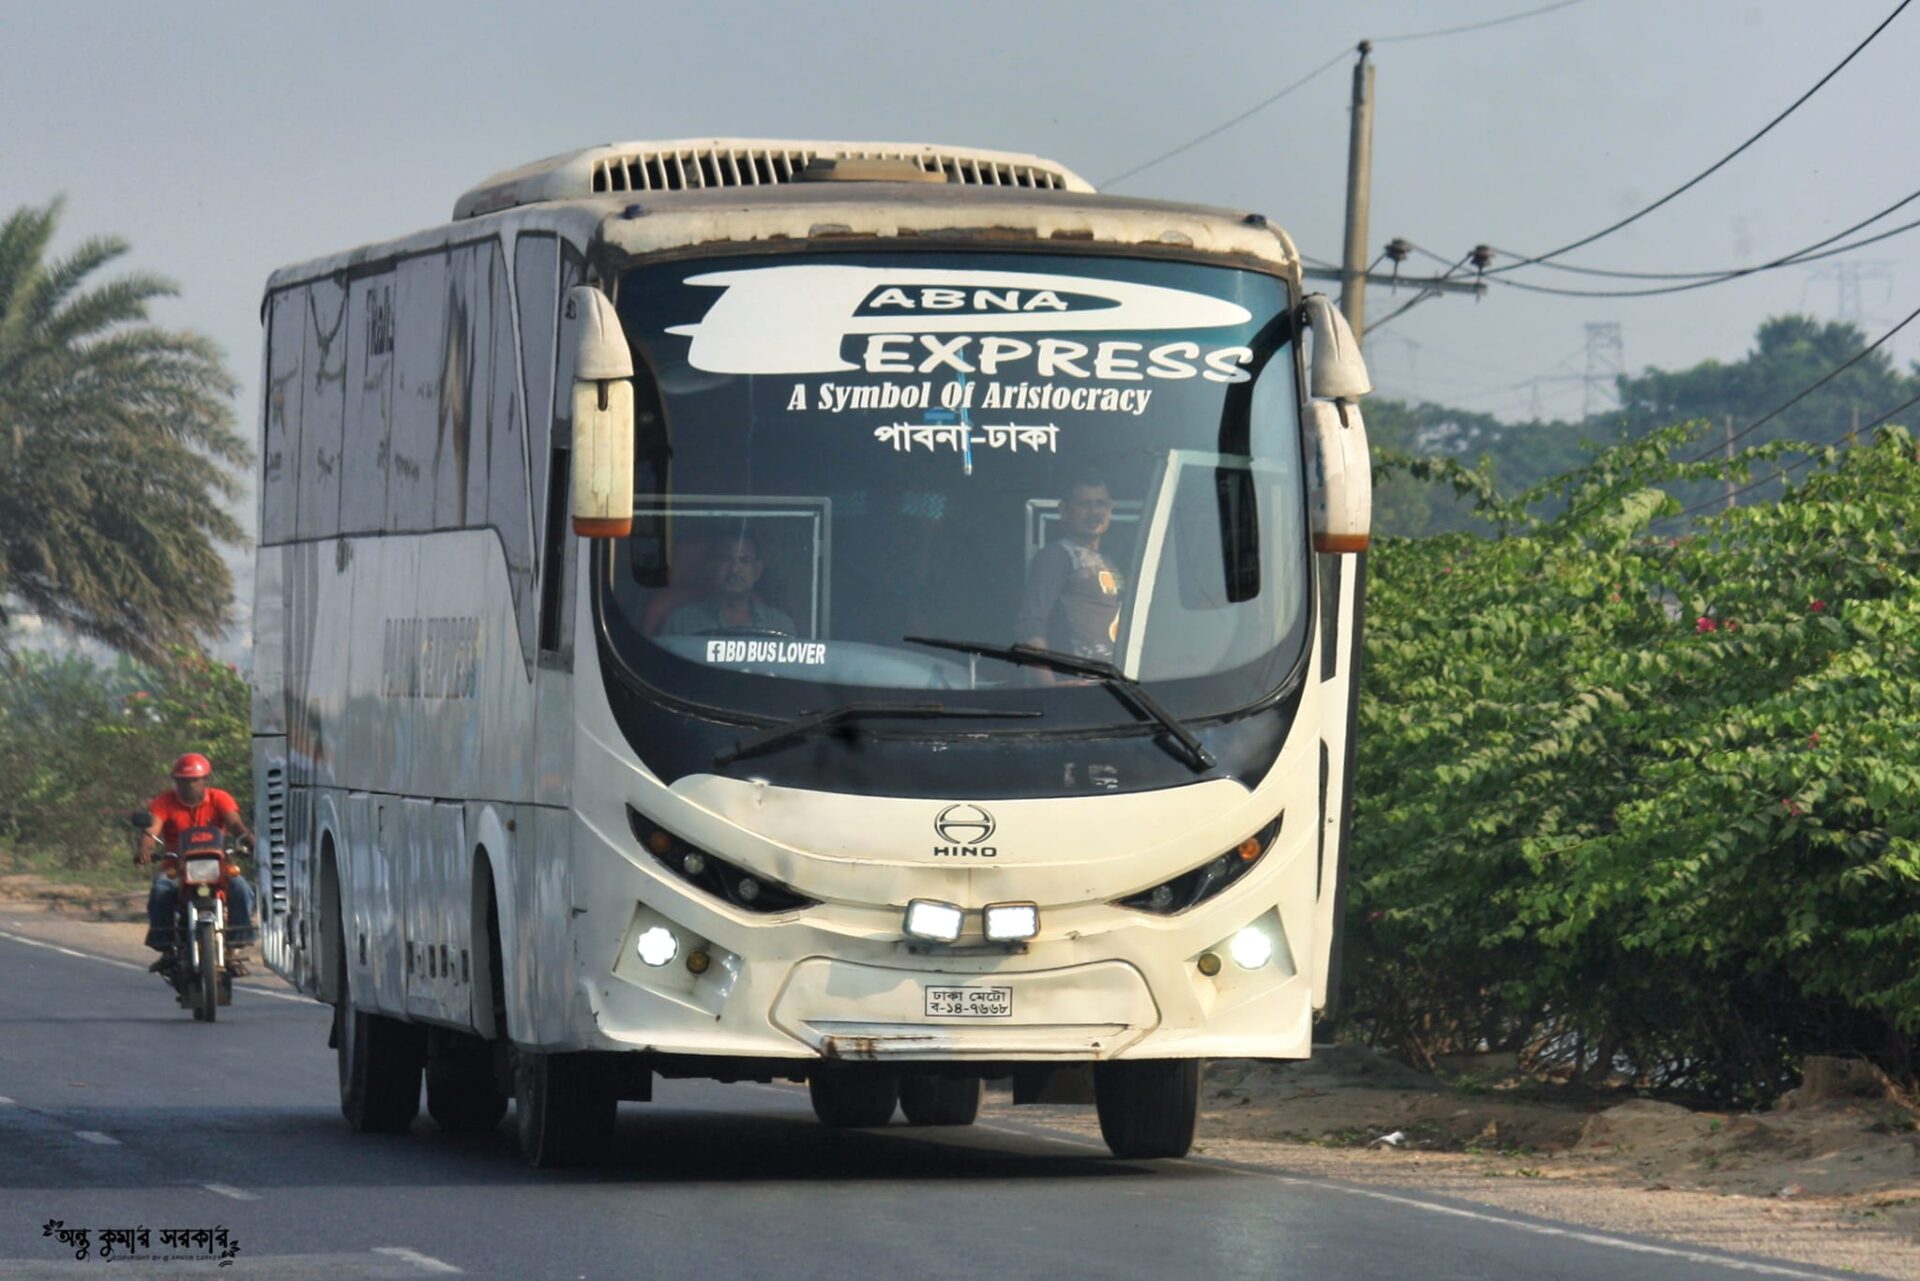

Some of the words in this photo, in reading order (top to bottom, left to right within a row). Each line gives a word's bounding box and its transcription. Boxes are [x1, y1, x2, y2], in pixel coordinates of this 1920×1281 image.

[864, 333, 1254, 383] EXPRESS
[787, 384, 808, 411] A
[818, 382, 929, 411] Symbol
[940, 382, 975, 412] Of
[982, 381, 1152, 416] Aristocracy
[874, 425, 1059, 454] পাবনা-ঢাকা
[726, 641, 746, 662] BD
[747, 641, 777, 662] BUS
[778, 642, 826, 664] LOVER
[934, 846, 997, 857] HINO
[932, 991, 963, 1002] ঢাকা
